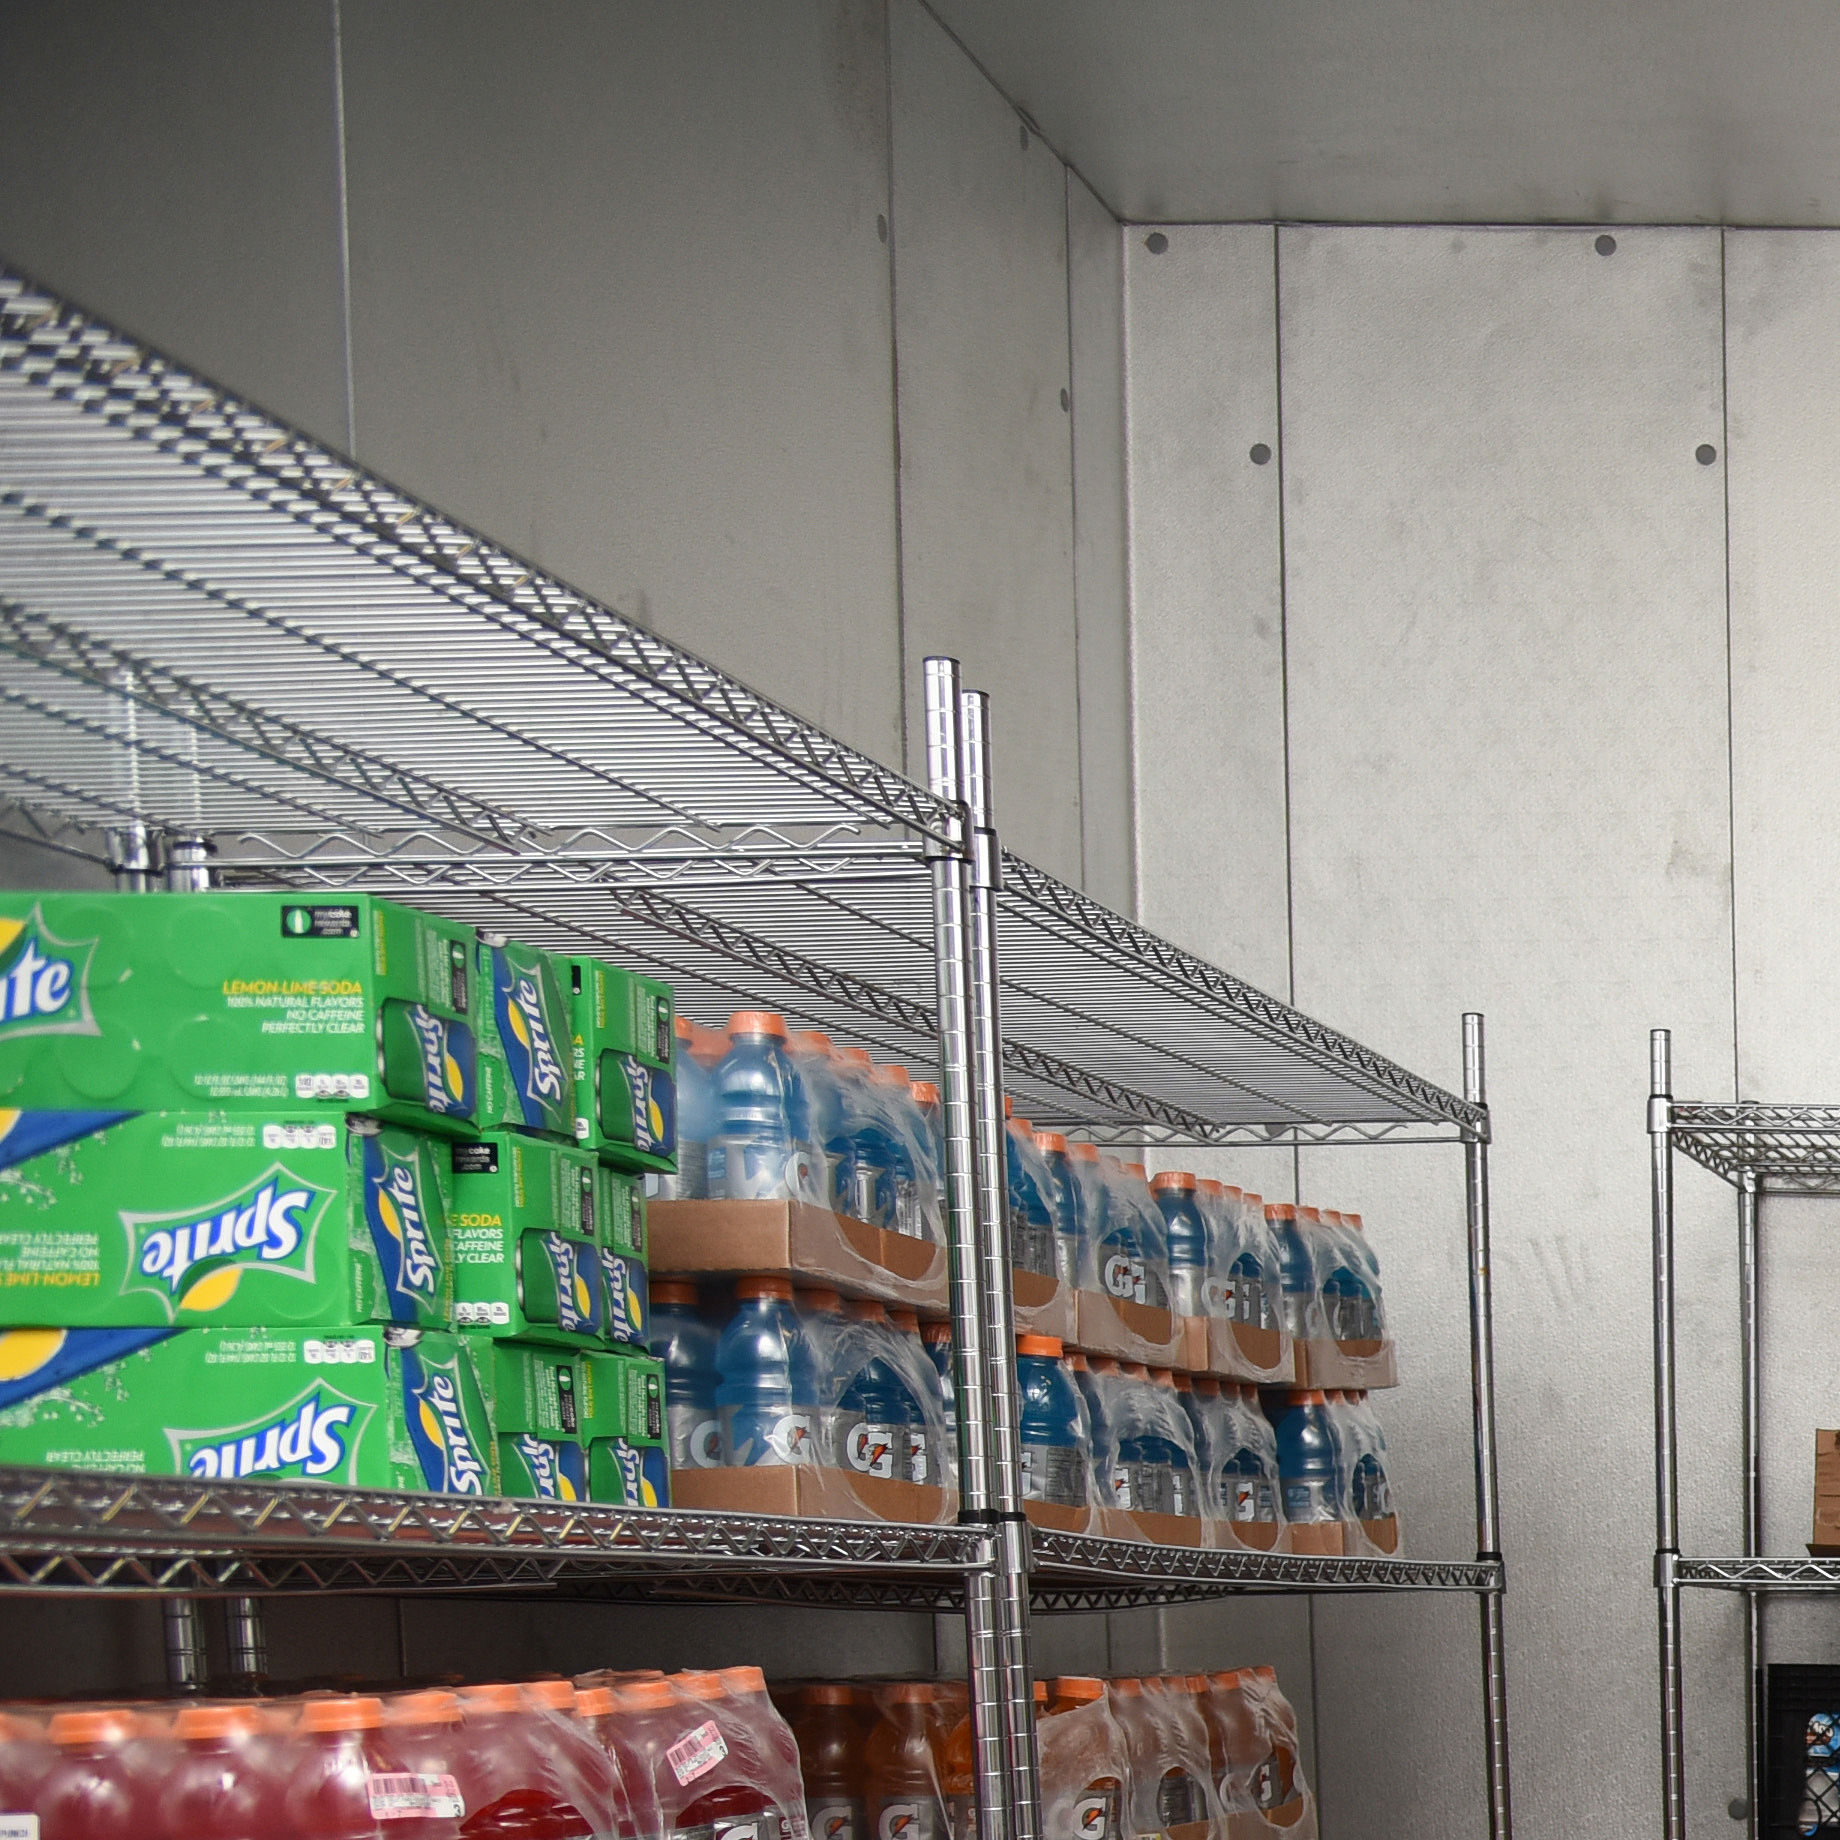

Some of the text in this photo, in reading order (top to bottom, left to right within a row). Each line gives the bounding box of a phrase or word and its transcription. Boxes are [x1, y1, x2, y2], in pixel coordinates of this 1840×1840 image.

[223, 980, 363, 995] LEMON-LIME SODA
[255, 996, 365, 1008] NATURAL FLAVORS
[261, 1022, 365, 1034] PERFECTLY CLEAR
[286, 1009, 365, 1021] NO CAFFEINE
[412, 1003, 454, 1115] Sprite
[518, 978, 568, 1102] Sprite
[627, 1053, 655, 1153] Sprite
[140, 1178, 314, 1294] Sprite
[388, 1165, 436, 1294] Sprite
[460, 1214, 502, 1227] SODA
[467, 1253, 504, 1264] CLEAR
[550, 1230, 577, 1333] Sprite
[600, 1246, 631, 1344] Sprite
[428, 1374, 484, 1497] Sprite
